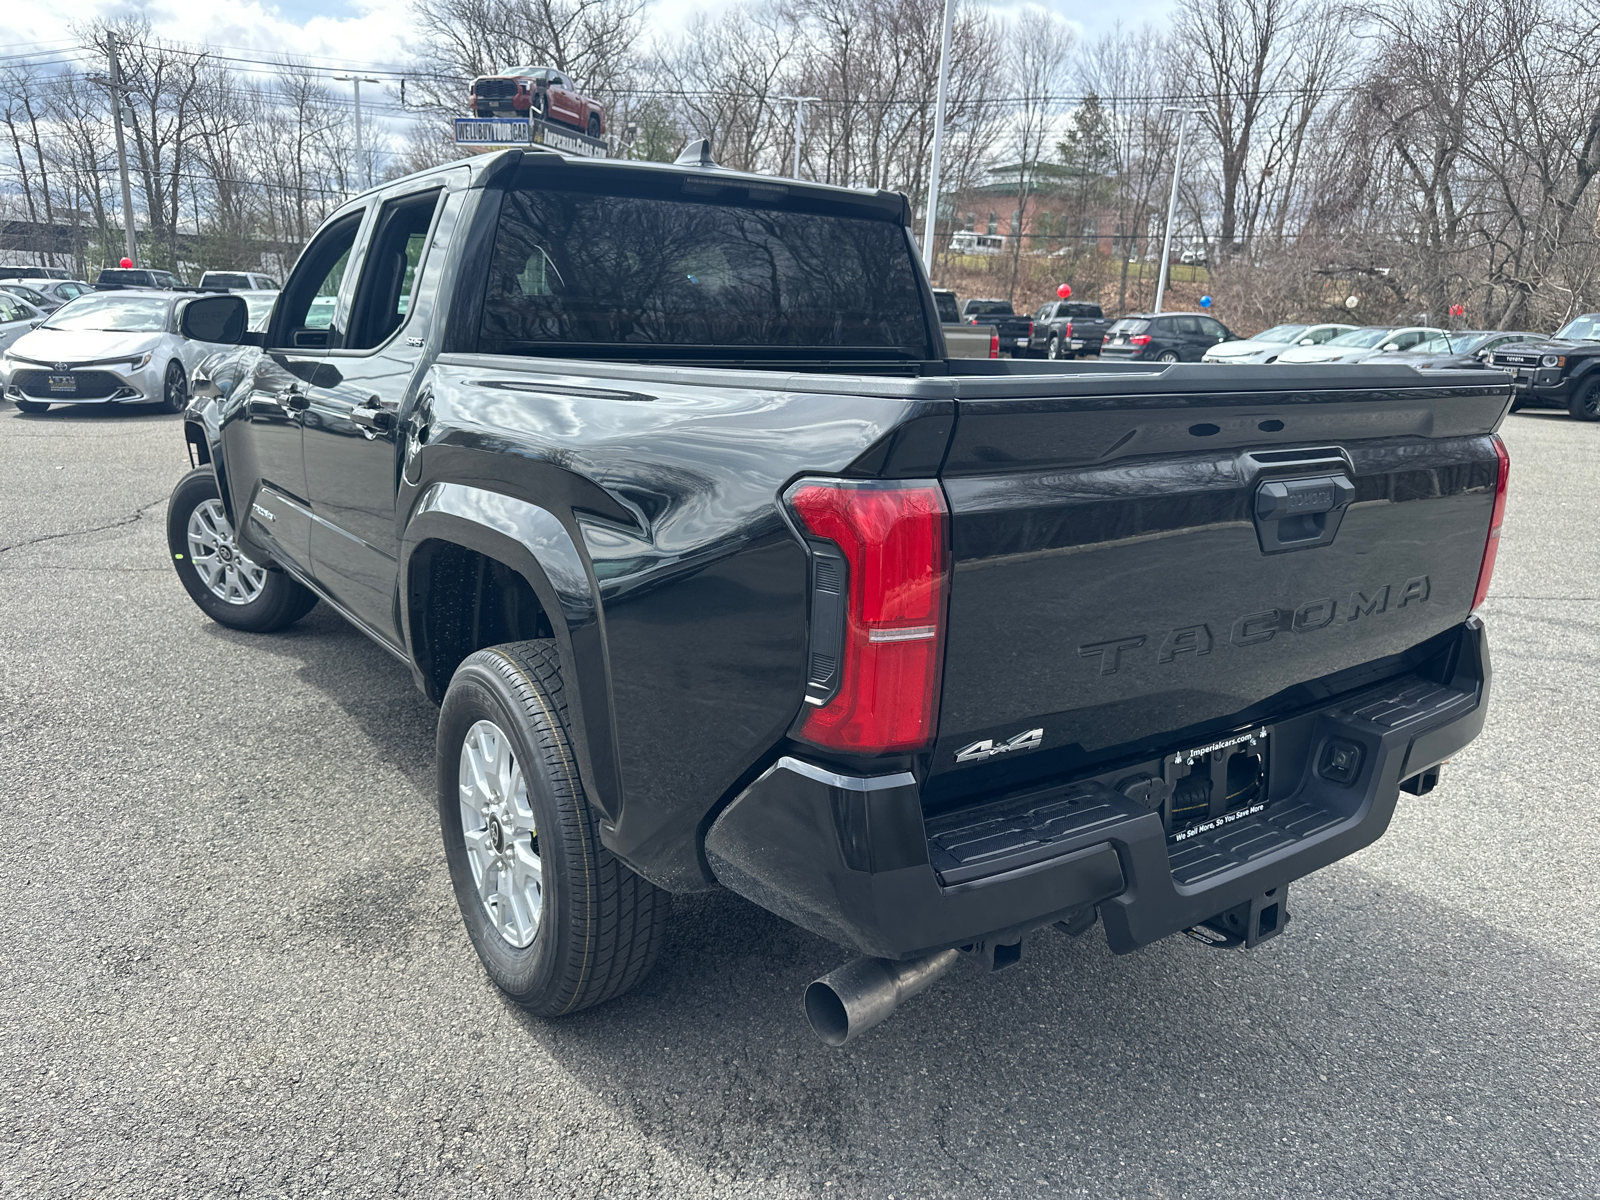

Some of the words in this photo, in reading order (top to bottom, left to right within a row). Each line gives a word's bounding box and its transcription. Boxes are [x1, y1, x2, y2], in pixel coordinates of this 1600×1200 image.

[477, 122, 492, 141] BUY
[492, 122, 512, 141] YOUR
[512, 122, 529, 142] CAR
[1289, 490, 1332, 507] TOYOTA
[1078, 574, 1431, 676] TACOMA
[1190, 733, 1252, 758] Imperialcars.com
[1176, 832, 1186, 841] We
[1186, 828, 1198, 837] Sell
[1199, 822, 1215, 833] More,
[1216, 818, 1224, 826] So
[1225, 814, 1235, 823] You
[1236, 810, 1249, 819] Save
[1250, 804, 1264, 814] More
